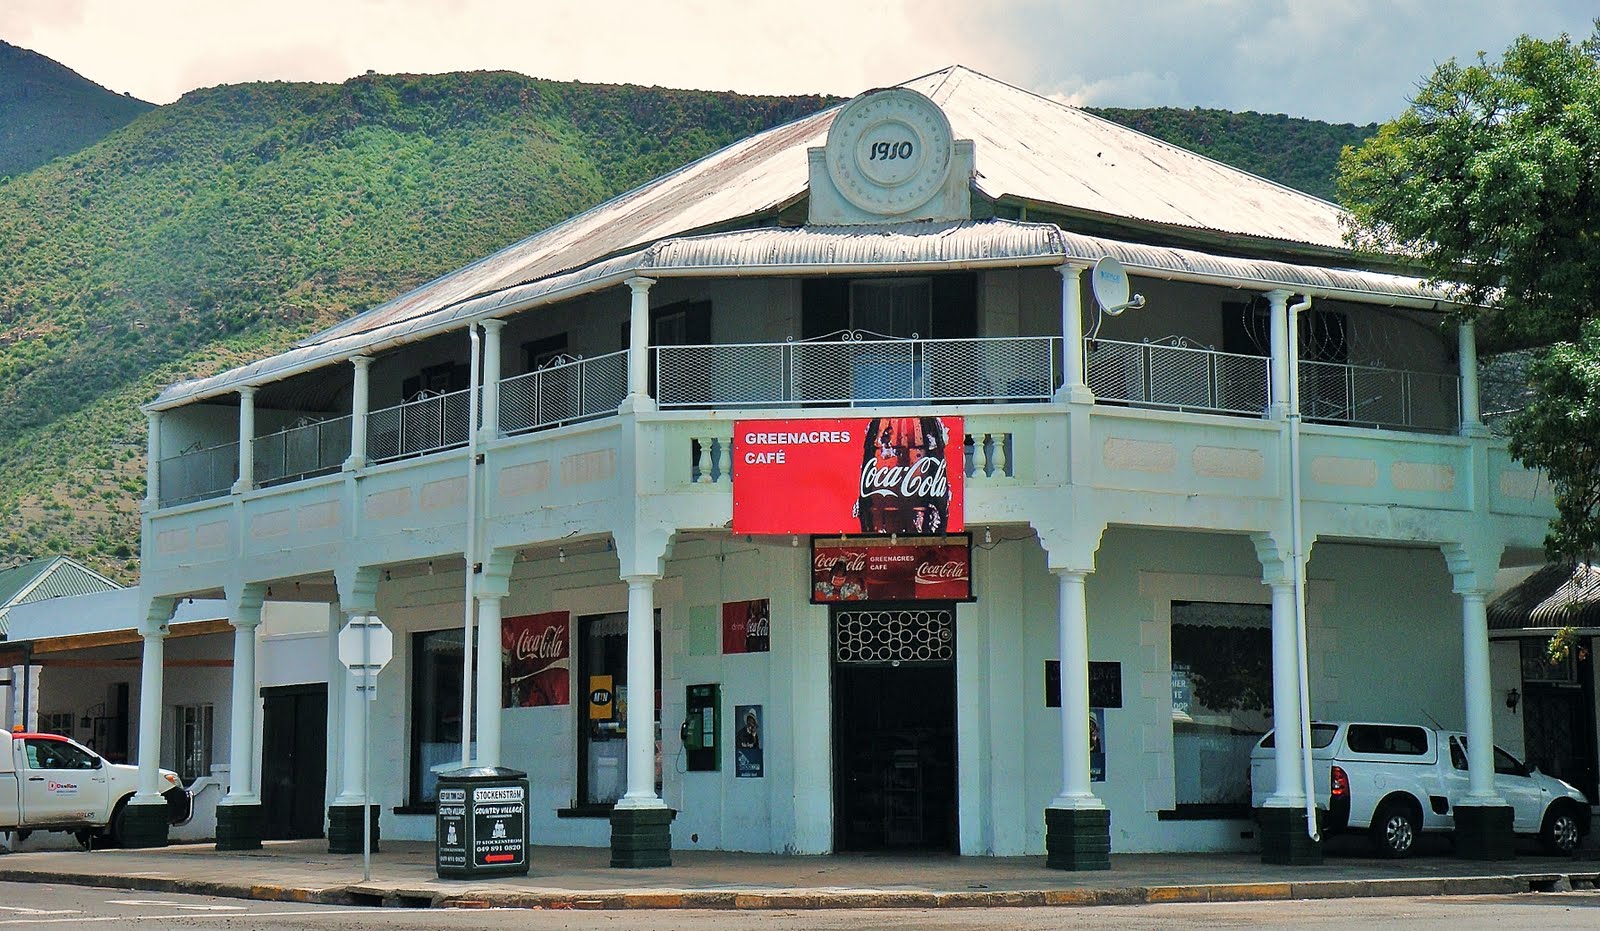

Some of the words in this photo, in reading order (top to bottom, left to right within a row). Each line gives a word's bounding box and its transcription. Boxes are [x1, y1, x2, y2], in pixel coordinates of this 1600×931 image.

[869, 141, 914, 161] 1910
[745, 431, 851, 445] GREENACRES
[745, 449, 786, 464] CAFÉ
[860, 456, 948, 498] Coca-Cola
[814, 552, 868, 572] Cocaola
[869, 555, 915, 563] GREENACRES
[917, 561, 966, 578] Coca-Cola
[516, 625, 565, 661] Coca-Cola
[593, 692, 609, 703] MTN
[475, 807, 499, 815] COUNTRY
[501, 806, 522, 814] VILLAGE
